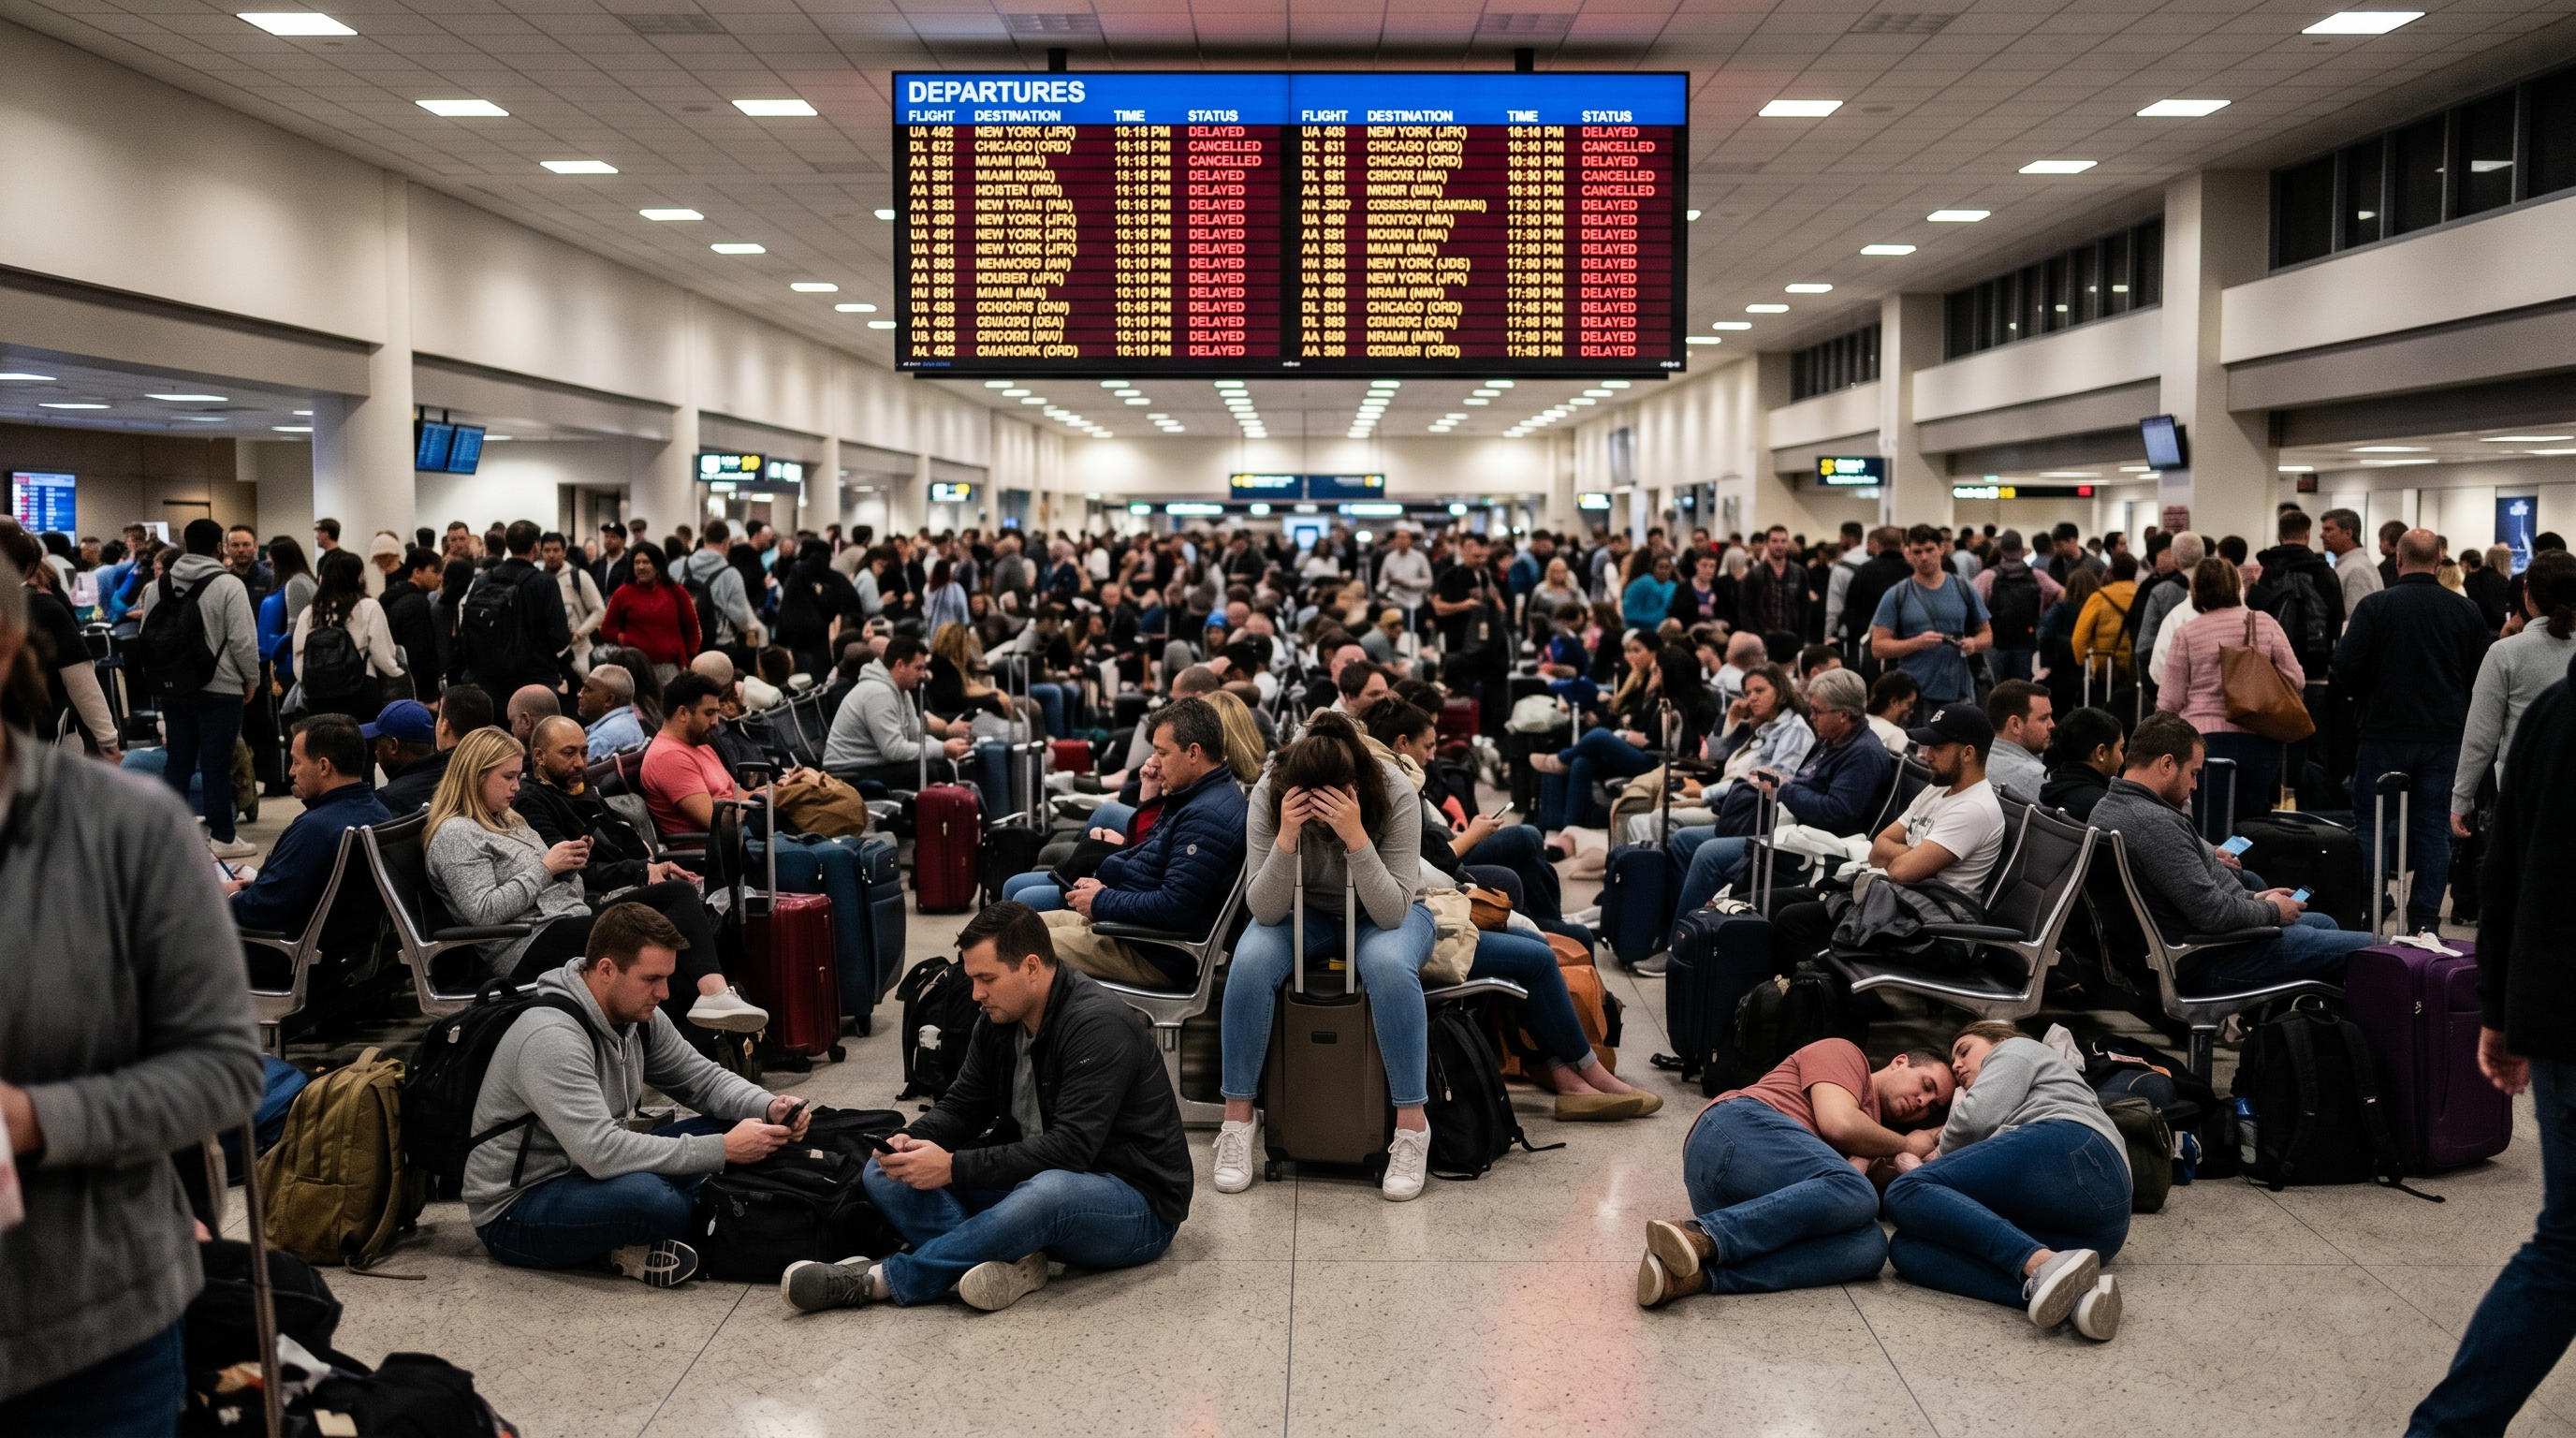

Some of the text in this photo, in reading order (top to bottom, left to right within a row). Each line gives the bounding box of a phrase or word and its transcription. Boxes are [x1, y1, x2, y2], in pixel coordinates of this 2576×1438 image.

[909, 81, 1085, 102] DEPARTURES
[909, 110, 1237, 122] FLIGHT DESTINATION TIME STATUS
[1302, 110, 1632, 122] FLIGHT DESTINATION TIME STATUS
[910, 126, 1245, 139] UA NEW YORK (JFK) PM DELAYED
[1302, 126, 1638, 139] UA NEW YORK (JFK) PM DELAYED
[910, 140, 928, 152] DL
[974, 140, 1032, 152] CHICAGO
[1151, 140, 1171, 152] PM
[1189, 140, 1262, 152] CANCELLED
[1302, 140, 1655, 154] DL CHICAGO (ORD) PM CANCELLED
[910, 155, 1262, 169] AA MIAMI (MIA) PM CANCELLED
[1302, 155, 1320, 167] DL
[1367, 155, 1425, 167] CHICAGO
[1427, 155, 1462, 169] (ORD)
[1544, 155, 1564, 167] PM
[1582, 155, 1638, 167] DELAYED
[910, 169, 927, 181] AA
[975, 169, 1013, 181] MIAMI
[1151, 169, 1171, 181] PM
[1189, 169, 1245, 181] DELAYED
[1302, 170, 1320, 182] DL
[1544, 170, 1564, 182] PM
[1582, 170, 1655, 182] CANCELLED
[910, 184, 1245, 196] AA PM DELAYED
[1302, 184, 1655, 197] AA PM CANCELLED
[910, 199, 1245, 211] AA NEW PM DELAYED
[1544, 199, 1638, 211] PM DELAYED
[911, 213, 1245, 227] UA NEW YORK (JFK) PM DELAYED
[1302, 214, 1638, 227] UA (MIA) PM DELAYED
[911, 228, 929, 240] UA
[976, 228, 1004, 240] NEW
[1007, 228, 1042, 240] YORK
[1045, 228, 1076, 242] (JFK)
[1151, 228, 1171, 240] PM
[1189, 228, 1245, 240] DELAYED
[1302, 228, 1637, 240] AA PM DELAYED
[911, 243, 1245, 255] UA NEW YORK PM DELAYED
[1302, 243, 1637, 257] AA MIAMI (MIA) PM DELAYED
[911, 257, 929, 269] AA
[1151, 257, 1171, 269] PM
[1189, 257, 1245, 269] DELAYED
[1367, 257, 1637, 270] NEW YORK PM DELAYED
[912, 272, 1245, 284] AA 10:10 PM DELAYED
[1302, 272, 1637, 284] UA NEW YORK PM DELAYED
[976, 286, 1245, 301] MIAMI (MIA) 10:10 PM DELAYED
[1302, 287, 1637, 299] AA PM DELAYED
[1151, 301, 1245, 313] PM DELAYED
[1302, 301, 1636, 315] DL CHICAGO (ORD) PM DELAYED
[912, 316, 1245, 328] AA 10:10 PM DELAYED
[1302, 316, 1320, 328] DL
[1544, 316, 1564, 328] PM
[1581, 316, 1636, 328] DELAYED
[1115, 330, 1149, 342] 10:10
[1151, 330, 1171, 342] PM
[1189, 330, 1245, 342] DELAYED
[1302, 330, 1636, 343] AA PM DELAYED
[1044, 345, 1078, 359] (ORD)
[1151, 345, 1171, 357] PM
[1189, 345, 1245, 357] DELAYED
[1302, 345, 1320, 357] AA
[1426, 345, 1460, 359] (ORD)
[1544, 345, 1564, 357] PM
[1581, 345, 1636, 357] DELAYED
